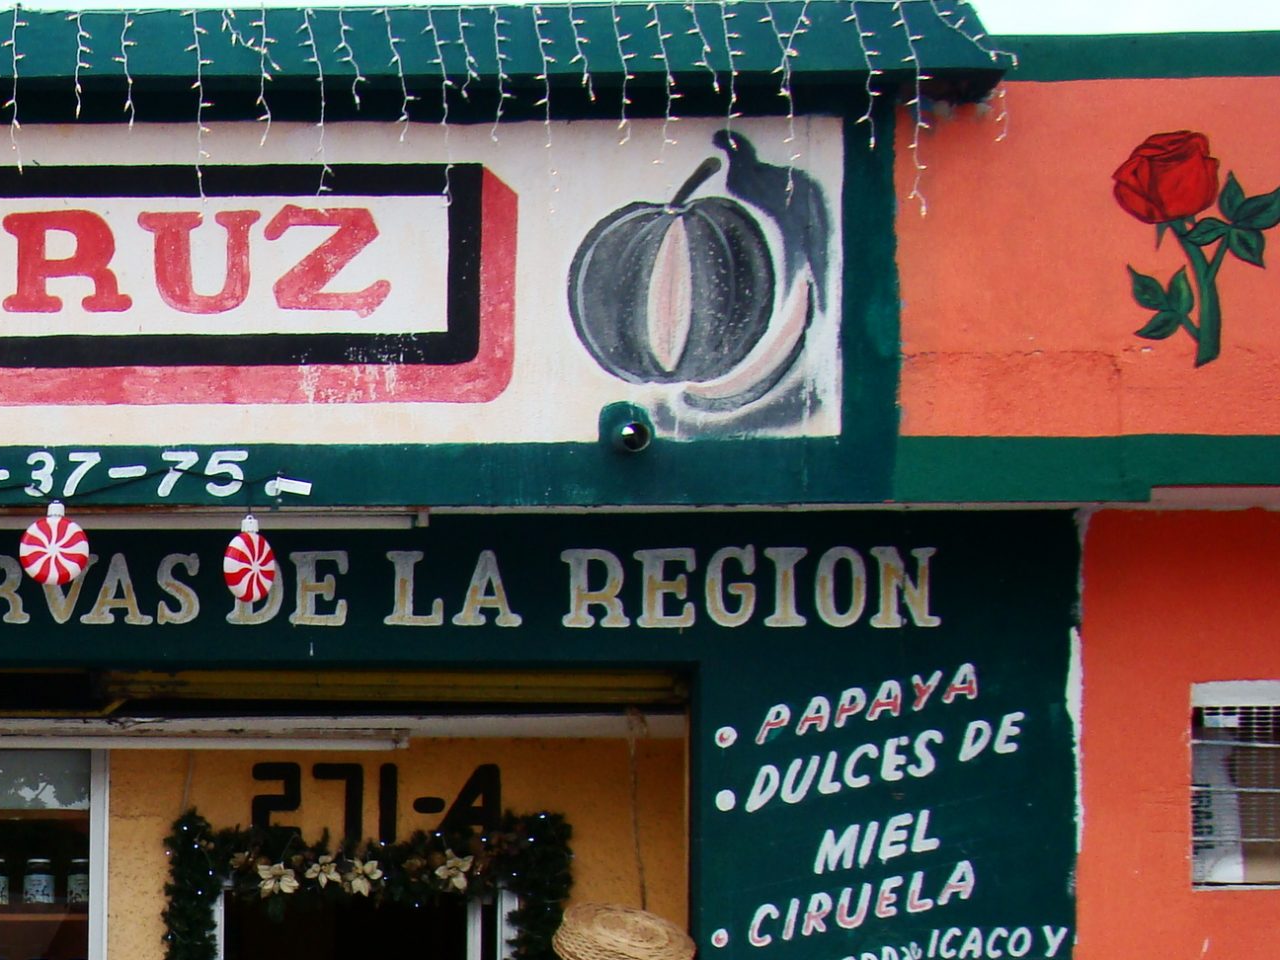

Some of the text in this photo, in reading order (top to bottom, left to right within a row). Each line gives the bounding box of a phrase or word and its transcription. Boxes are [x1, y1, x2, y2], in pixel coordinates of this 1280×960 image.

[383, 549, 522, 627] LA
[560, 543, 942, 628] REGION
[755, 662, 979, 746] PAPAYA
[252, 761, 502, 845] 271-A
[745, 711, 1025, 813] DULCES DE
[814, 809, 941, 874] MIEL
[748, 859, 976, 948] CIRUELA
[926, 926, 1033, 960] ICACO
[1042, 925, 1068, 959] Y
